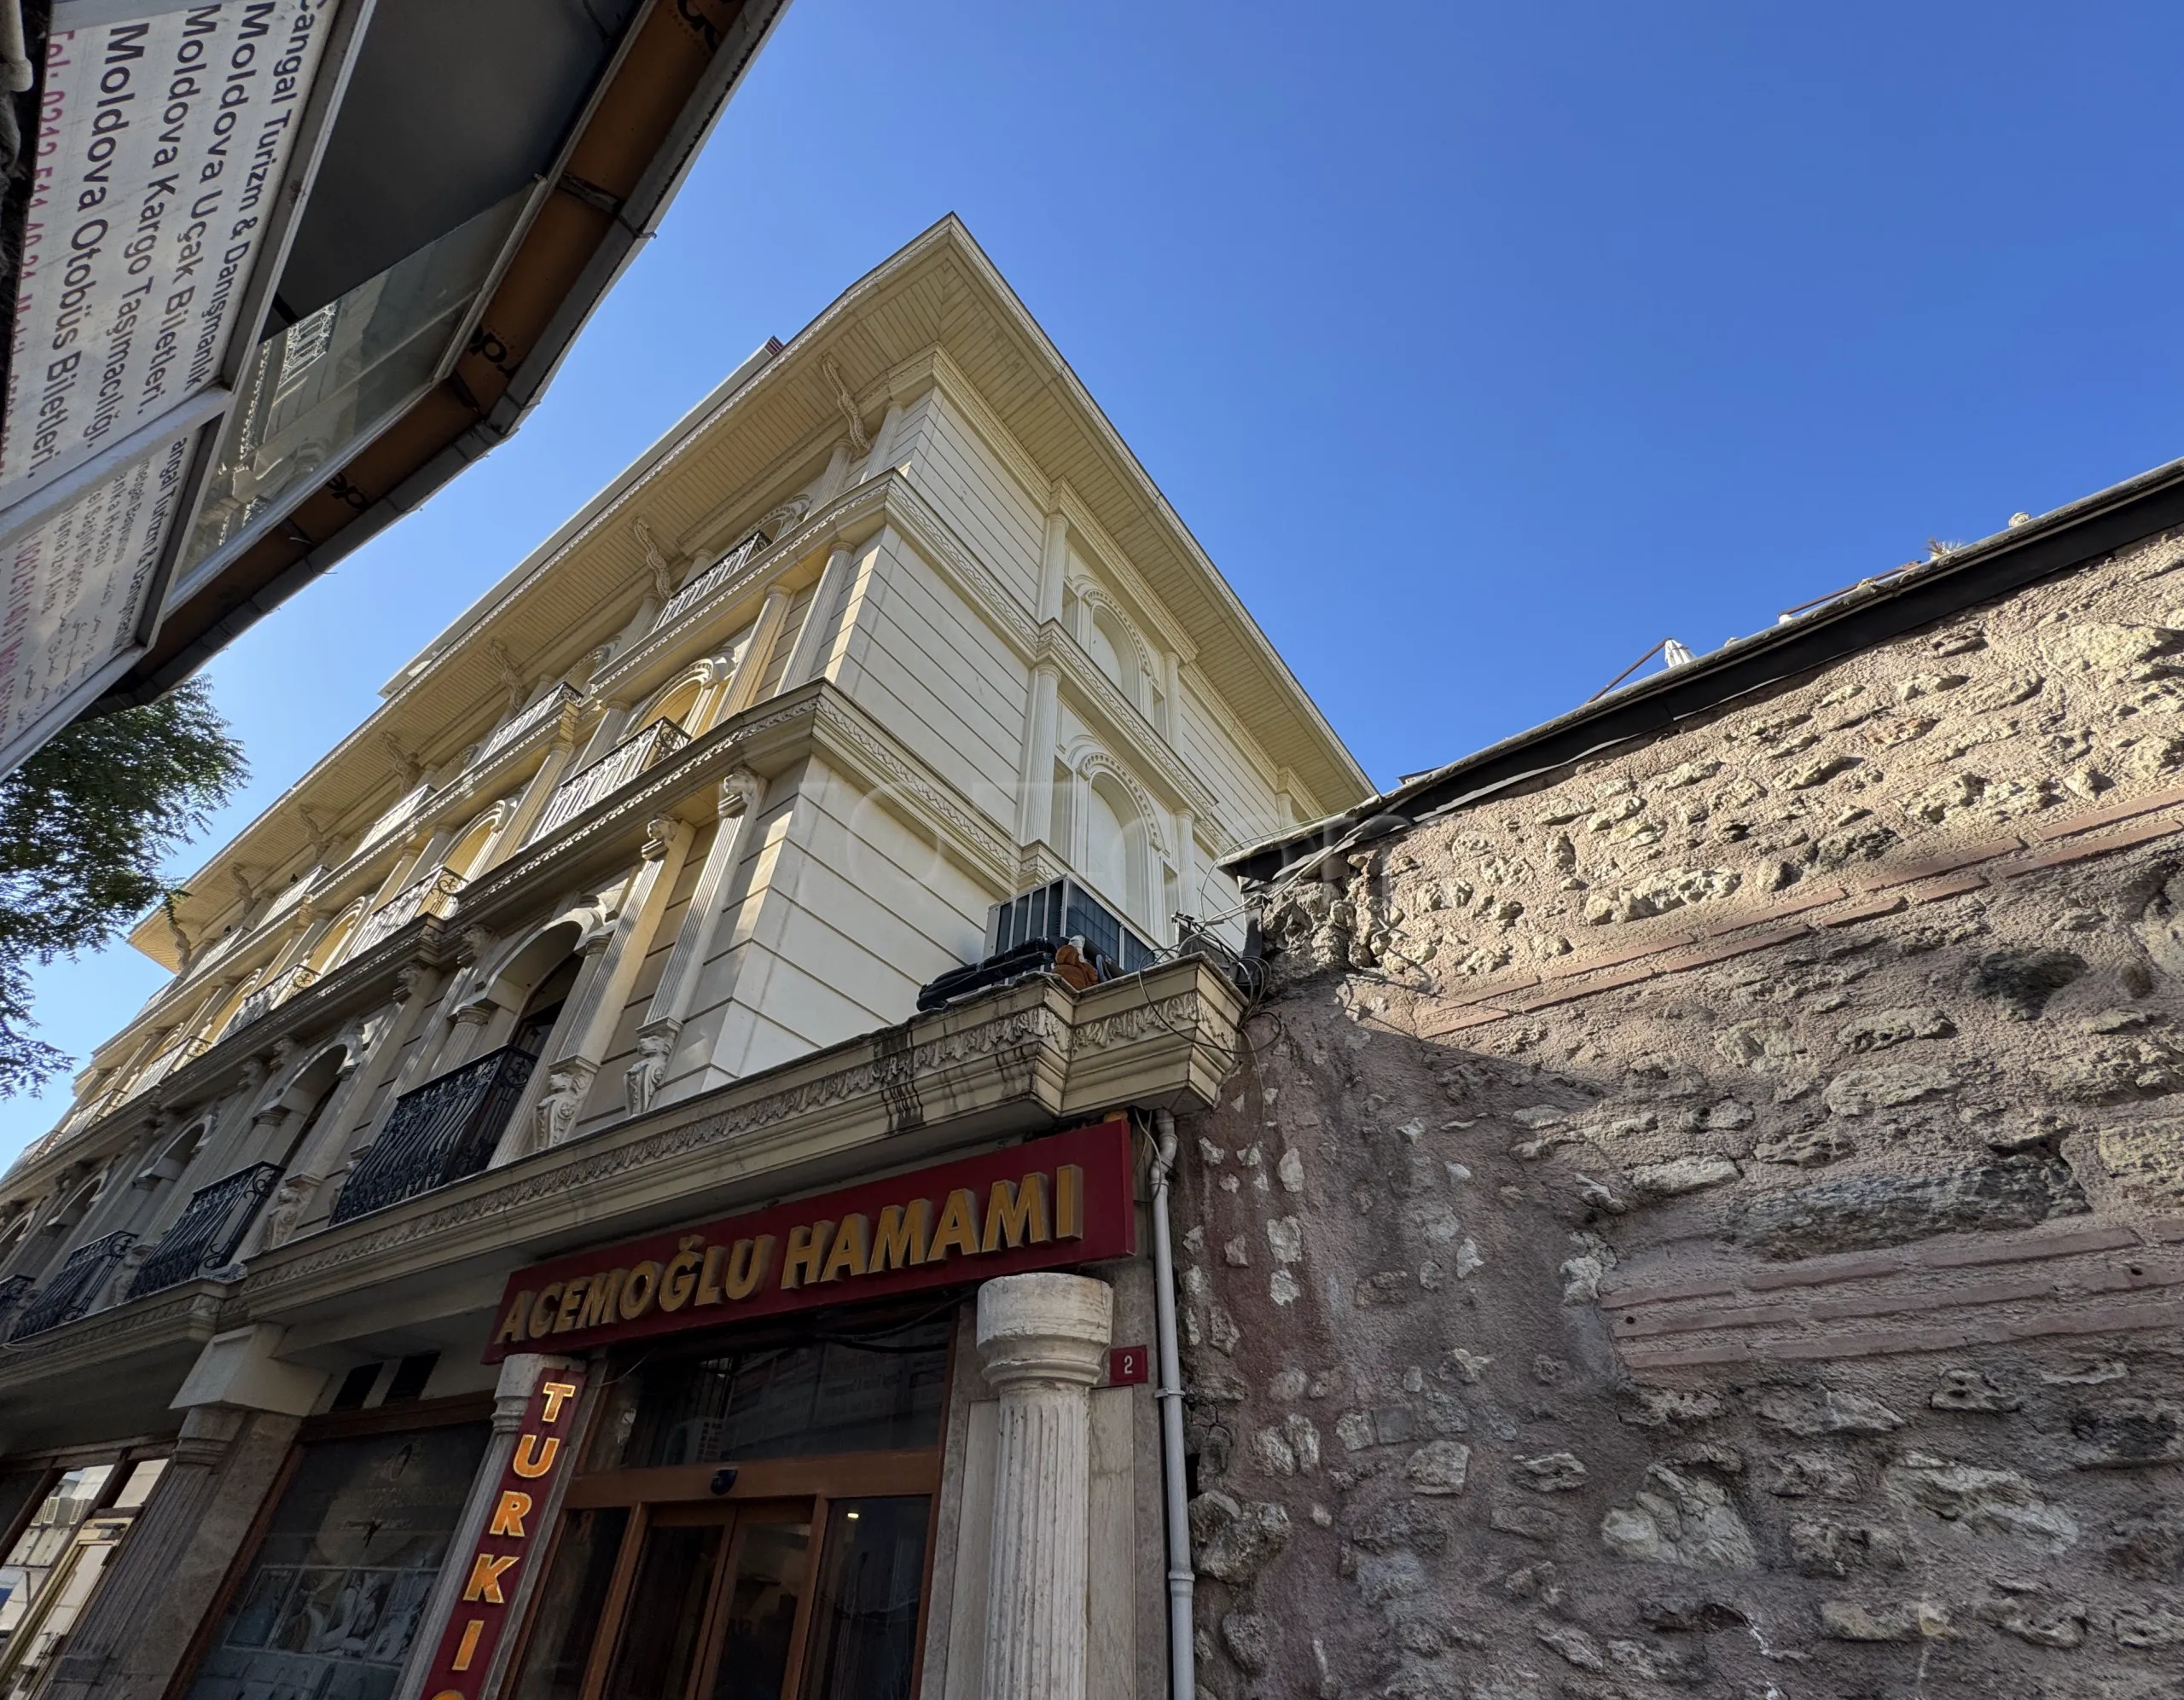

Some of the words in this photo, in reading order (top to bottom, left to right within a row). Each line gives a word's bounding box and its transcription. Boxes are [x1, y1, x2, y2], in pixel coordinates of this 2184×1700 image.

[78, 24, 150, 212] Moldova
[153, 4, 223, 169] Moldova
[200, 3, 276, 184] Moldova
[240, 110, 293, 212] Turizm
[125, 175, 180, 276] Kargo
[174, 191, 224, 284] Uçak
[230, 218, 258, 241] &
[53, 220, 109, 351] Otobüs
[186, 241, 252, 392] Danışmanlık
[138, 287, 196, 415] Biletleri.
[28, 351, 83, 479] Biletleri.
[160, 438, 189, 492] angal
[109, 473, 128, 513] anka
[142, 486, 177, 552] Turizm
[138, 547, 160, 568] &
[494, 1233, 777, 1345] ACEMOĞLU
[781, 1164, 1083, 1289] HAMAMI
[1124, 1355, 1134, 1375] 2
[430, 1381, 577, 1700] TURKI
